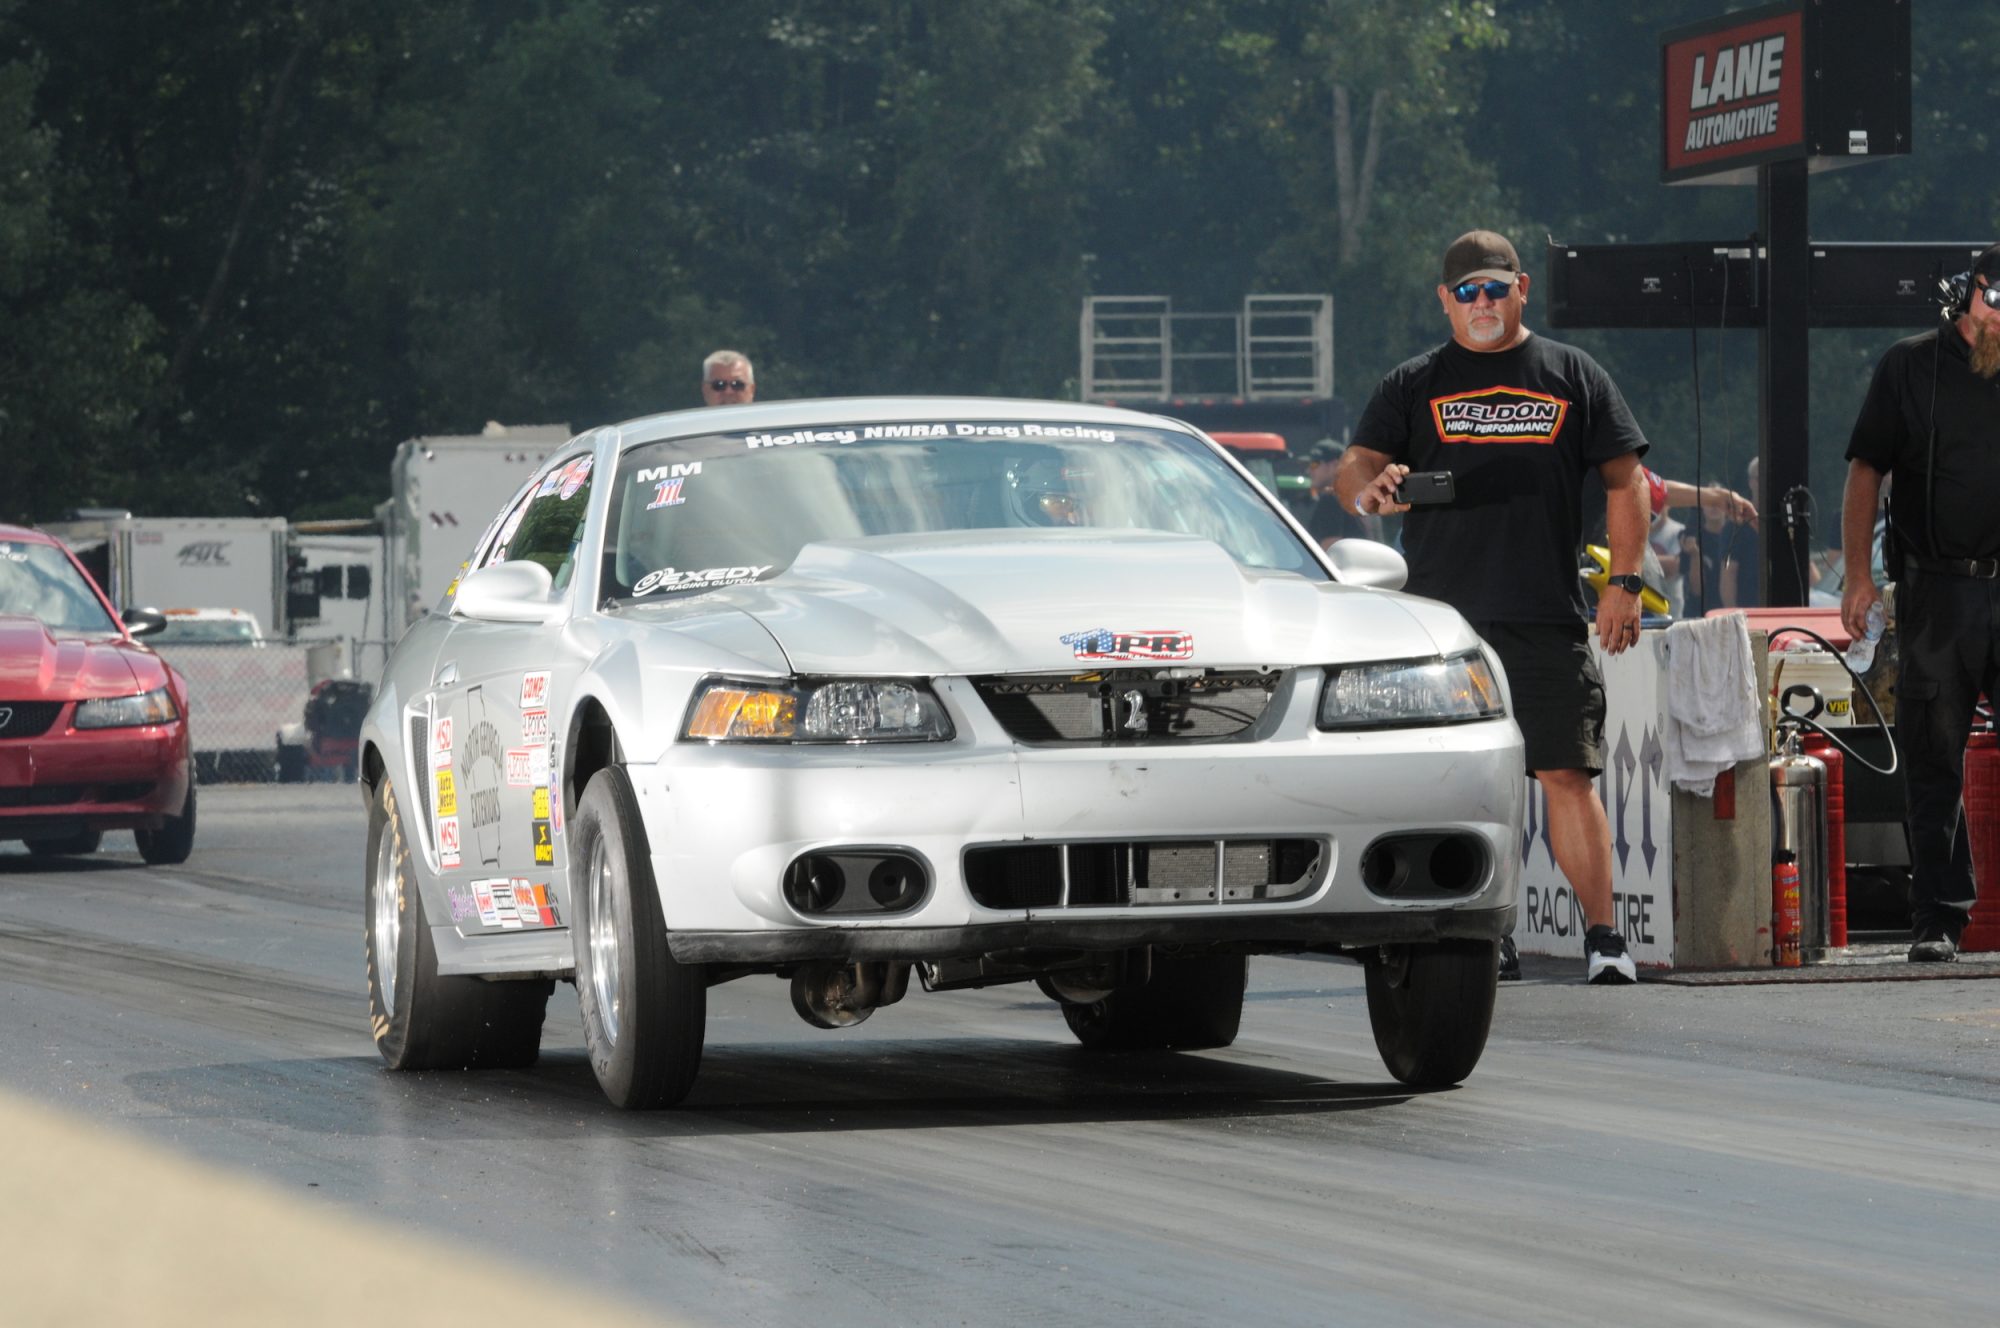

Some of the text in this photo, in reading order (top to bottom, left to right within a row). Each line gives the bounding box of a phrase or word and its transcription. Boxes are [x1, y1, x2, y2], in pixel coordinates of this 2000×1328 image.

[1690, 35, 1785, 110] LANE
[1684, 101, 1779, 151] AUTOMOTIVE
[1442, 401, 1557, 422] WELDON
[745, 424, 1115, 449] Holley NMRA Drag Racing
[1445, 420, 1553, 433] HIGH PERFORMANCE
[659, 565, 773, 586] EXEDY
[666, 577, 757, 592] RACING CLUTCH
[523, 677, 545, 699] COMP
[440, 821, 458, 849] MSD
[1527, 885, 1655, 944] RACIN TIRE
